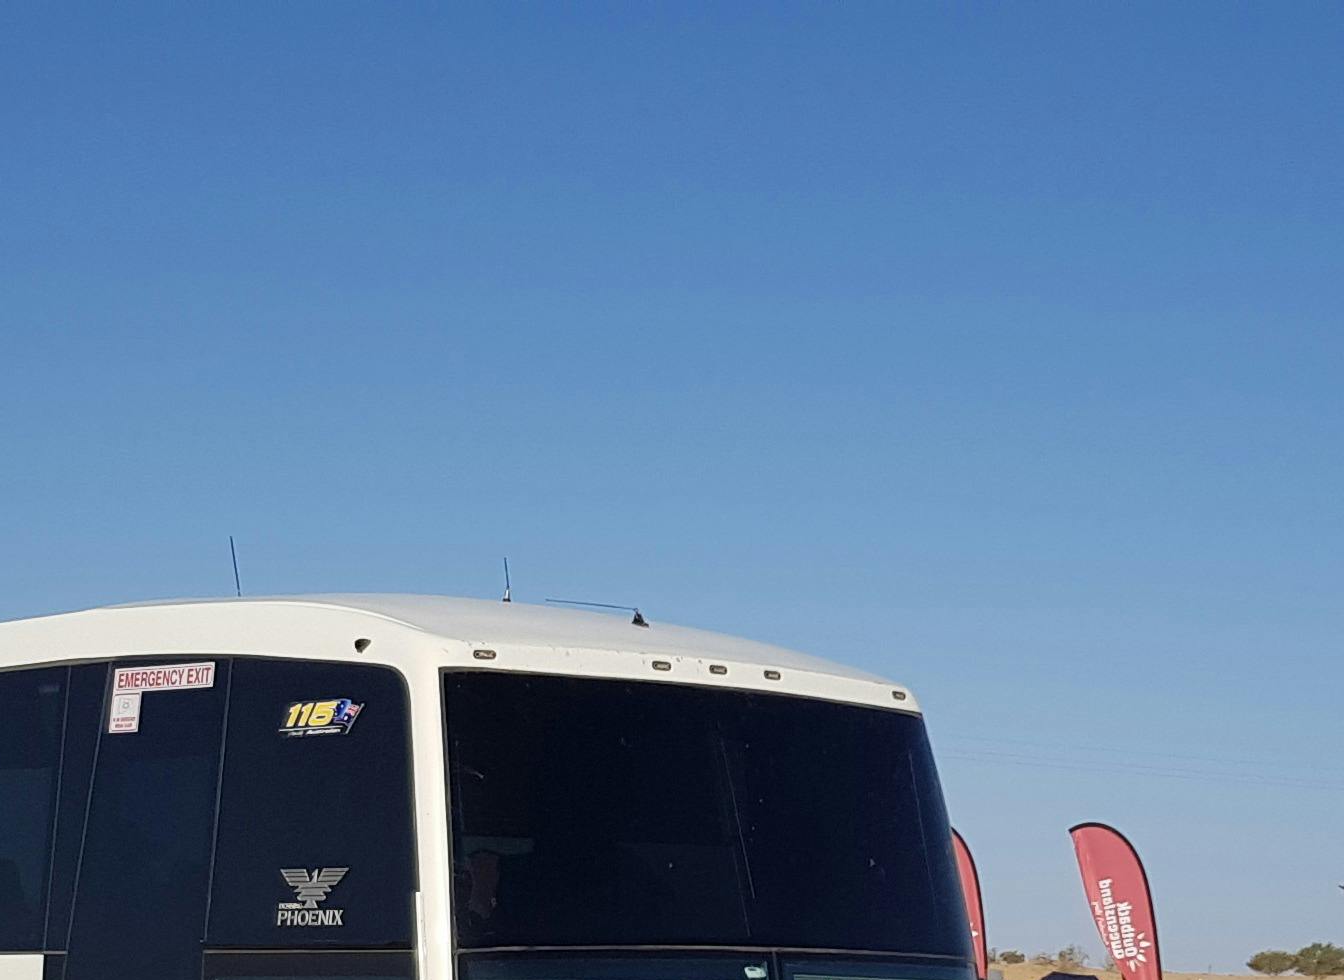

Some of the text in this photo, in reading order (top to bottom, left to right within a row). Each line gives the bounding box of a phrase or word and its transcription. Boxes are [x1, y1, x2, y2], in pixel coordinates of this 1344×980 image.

[117, 667, 211, 688] EMERGENCY EXIT
[277, 910, 344, 926] PHOENIX
